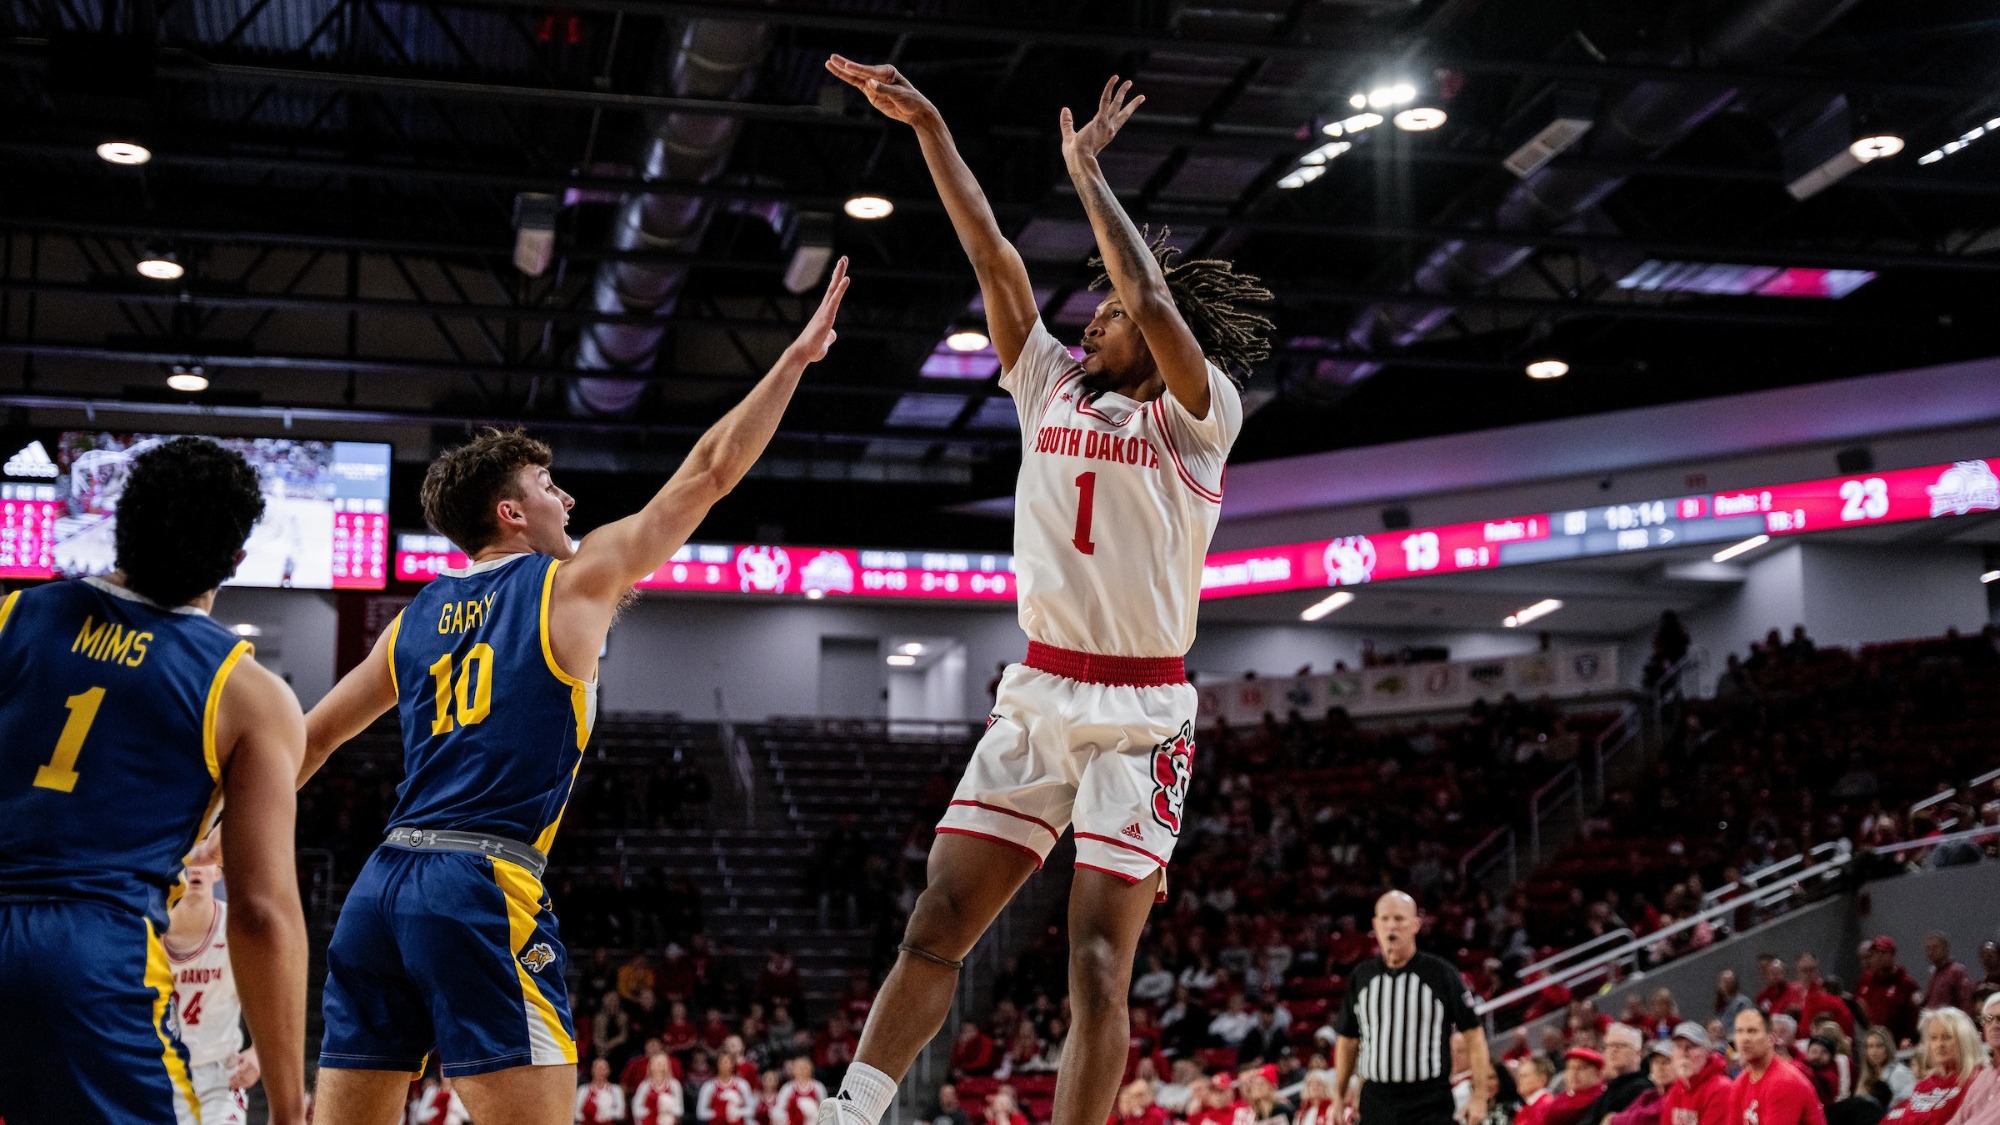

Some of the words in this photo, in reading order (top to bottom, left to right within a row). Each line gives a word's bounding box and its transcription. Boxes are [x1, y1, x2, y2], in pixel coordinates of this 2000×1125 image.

[1035, 426, 1083, 457] SOUTH
[1085, 429, 1159, 470] DAKOTA
[1071, 471, 1097, 556] 1
[1840, 478, 1889, 521] 23
[1401, 532, 1440, 571] 13
[71, 615, 154, 668] MIMS
[429, 643, 495, 737] 10
[33, 686, 107, 793] 1
[1121, 828, 1144, 841] adidas
